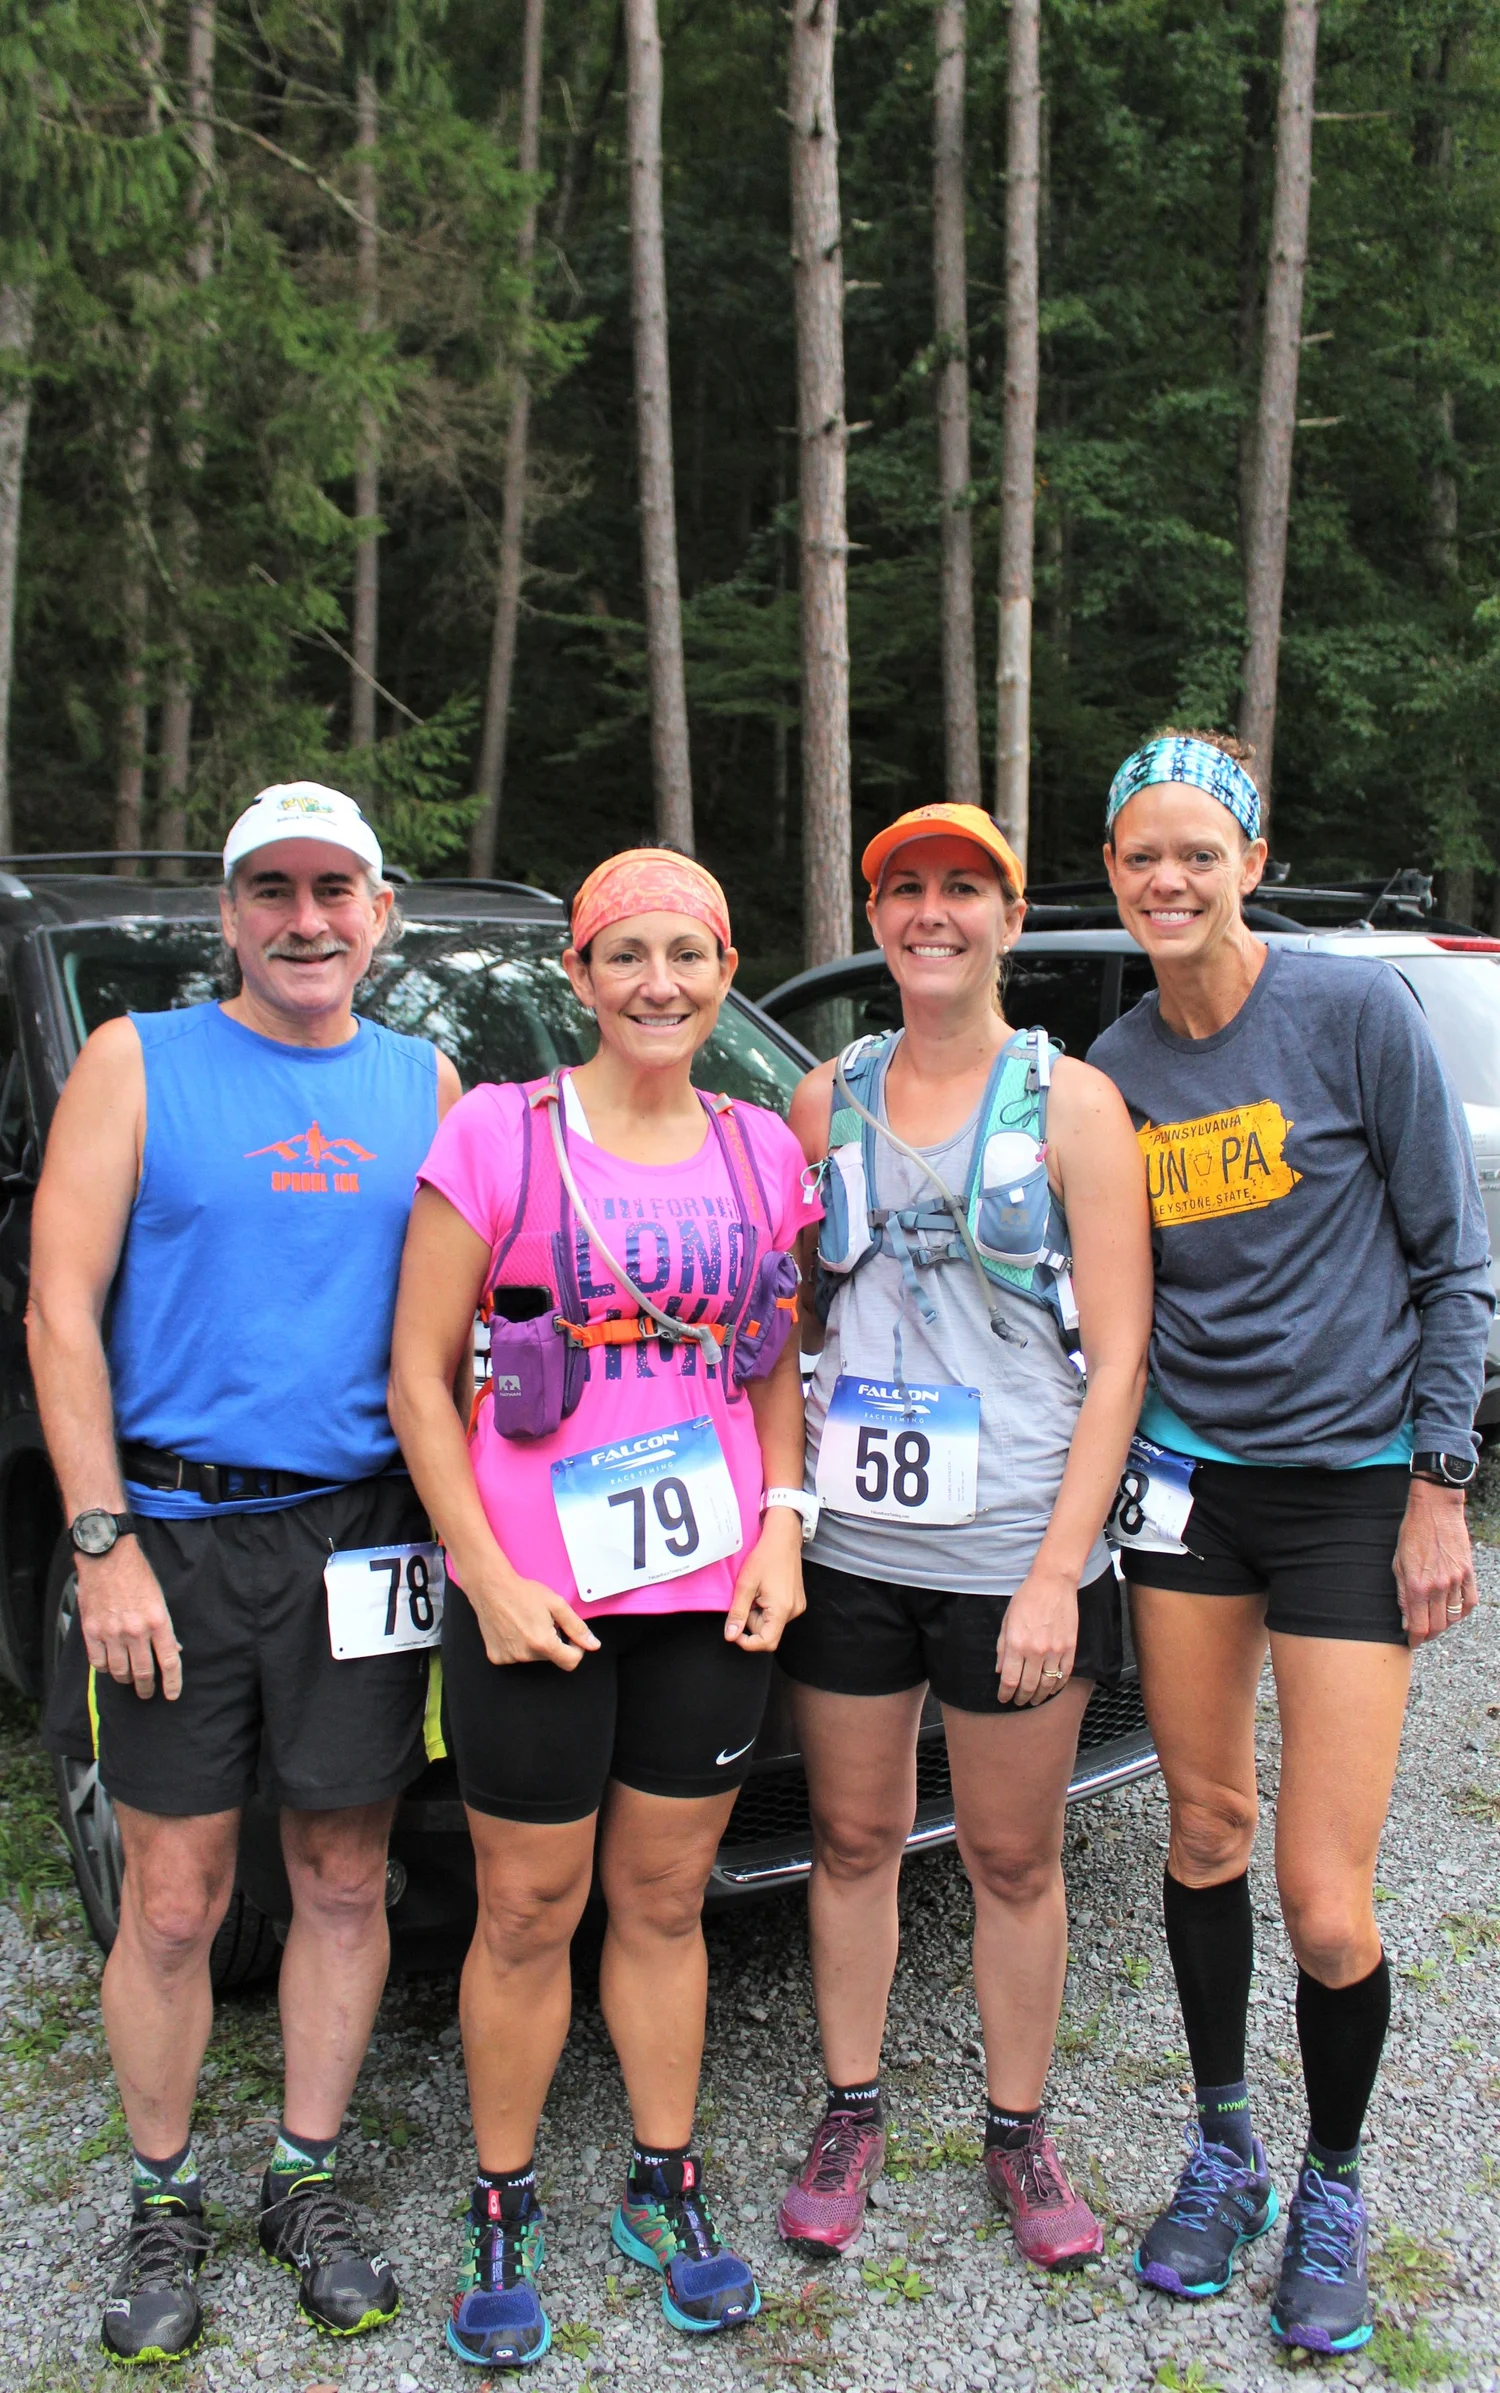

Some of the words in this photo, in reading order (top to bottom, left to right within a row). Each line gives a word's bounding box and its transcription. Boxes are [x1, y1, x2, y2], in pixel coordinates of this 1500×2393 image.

[1153, 1114, 1241, 1146] PENNSYLVANIA
[1146, 1148, 1189, 1199] UN
[1221, 1131, 1271, 1184] PA
[650, 1196, 701, 1219] FOR
[1216, 1187, 1251, 1204] STATE
[857, 1383, 939, 1403] FALCON
[864, 1412, 886, 1421] RACE
[889, 1415, 925, 1425] TIMING
[591, 1430, 680, 1467] FALCON
[1131, 1436, 1165, 1457] CON
[610, 1472, 635, 1486] RACE
[638, 1461, 674, 1478] TIMING
[855, 1425, 931, 1508] 58
[607, 1476, 700, 1571] 79
[369, 1554, 435, 1636] 78
